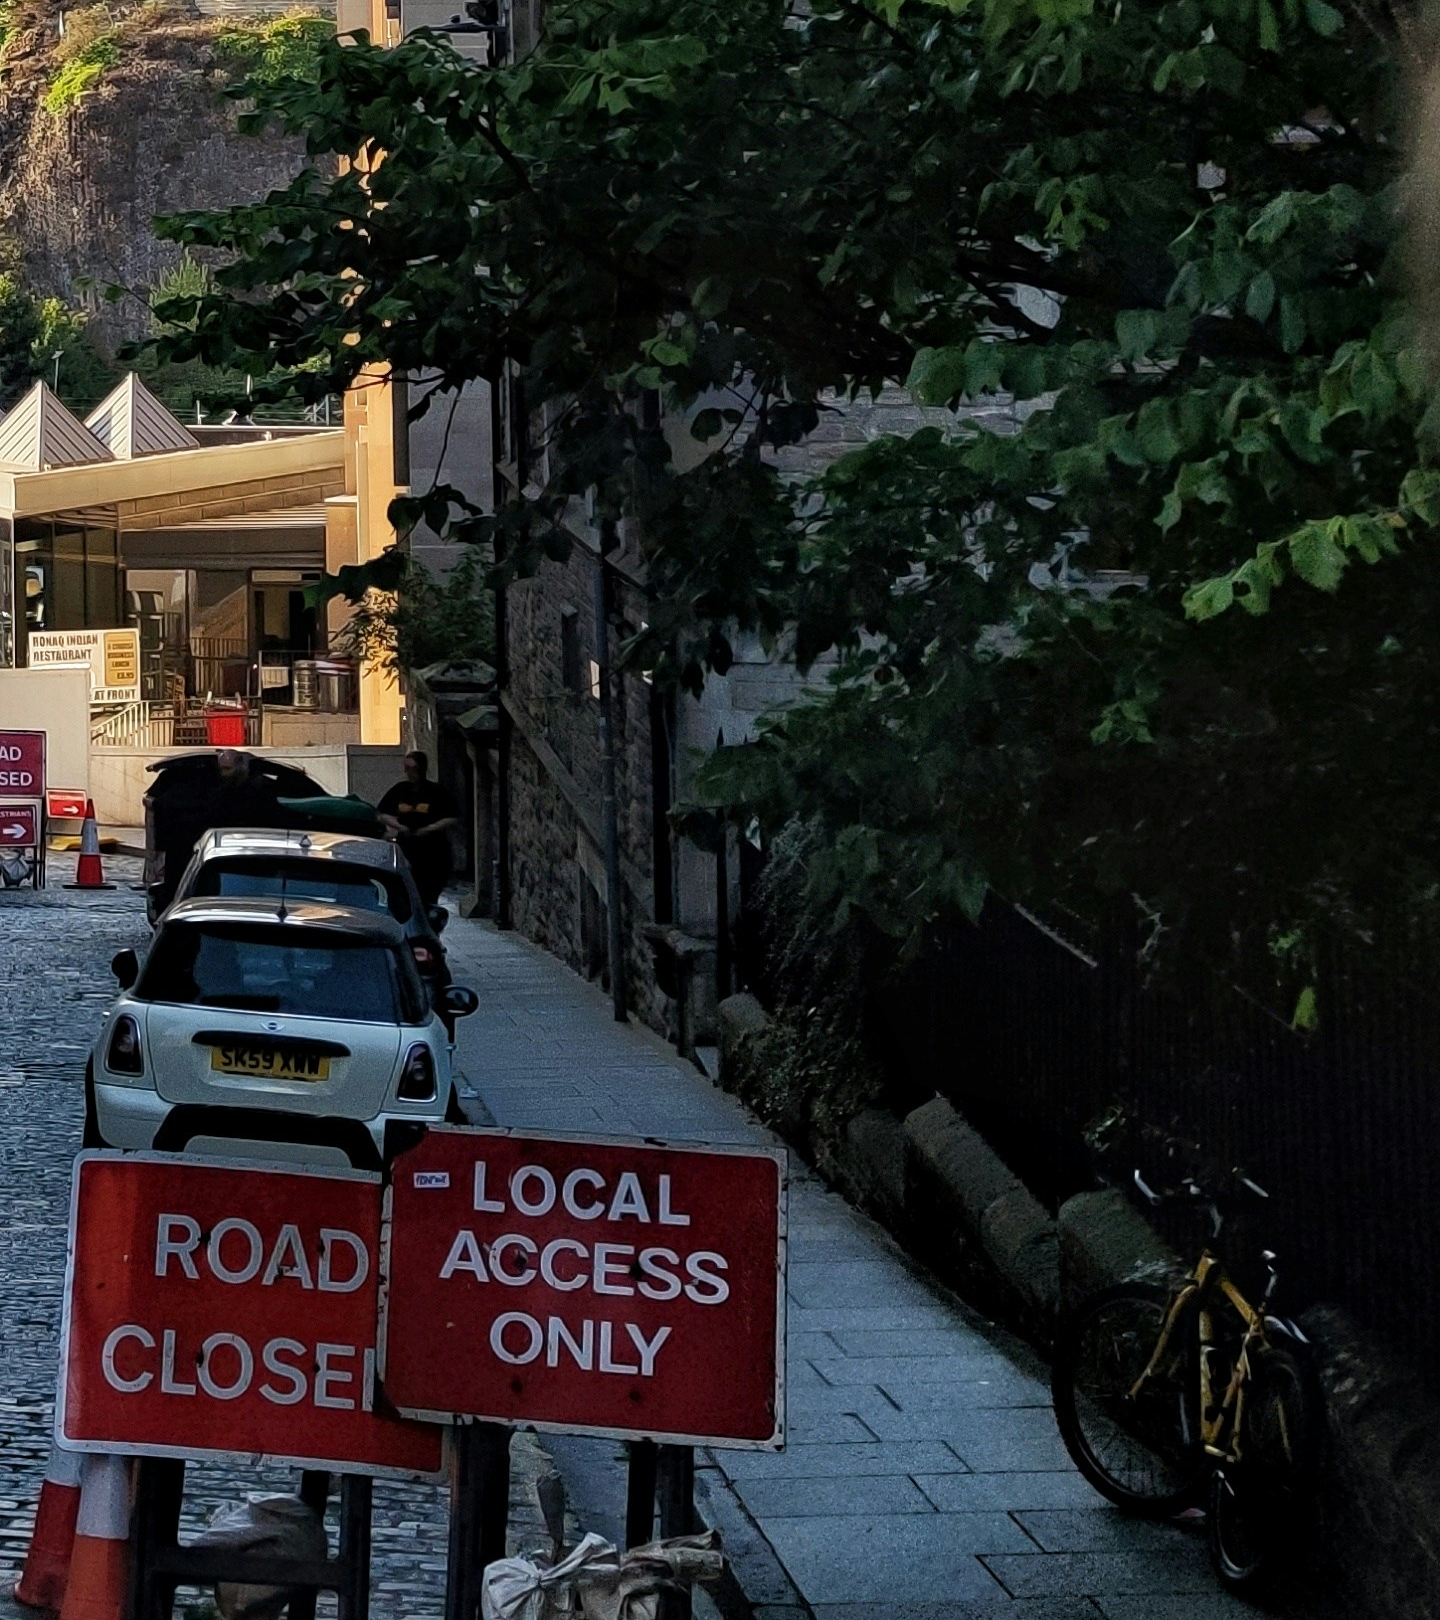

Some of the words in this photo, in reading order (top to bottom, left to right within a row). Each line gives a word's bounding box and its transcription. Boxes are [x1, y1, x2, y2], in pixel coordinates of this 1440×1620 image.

[34, 649, 92, 661] RESTAURANT
[67, 634, 98, 645] INDIAN
[108, 689, 136, 699] FRONT
[473, 1160, 691, 1227] LOCAL
[155, 1213, 369, 1293] ROAD
[440, 1230, 730, 1305] ACCESS
[102, 1324, 376, 1412] CLOSE
[490, 1311, 672, 1377] ONLY
